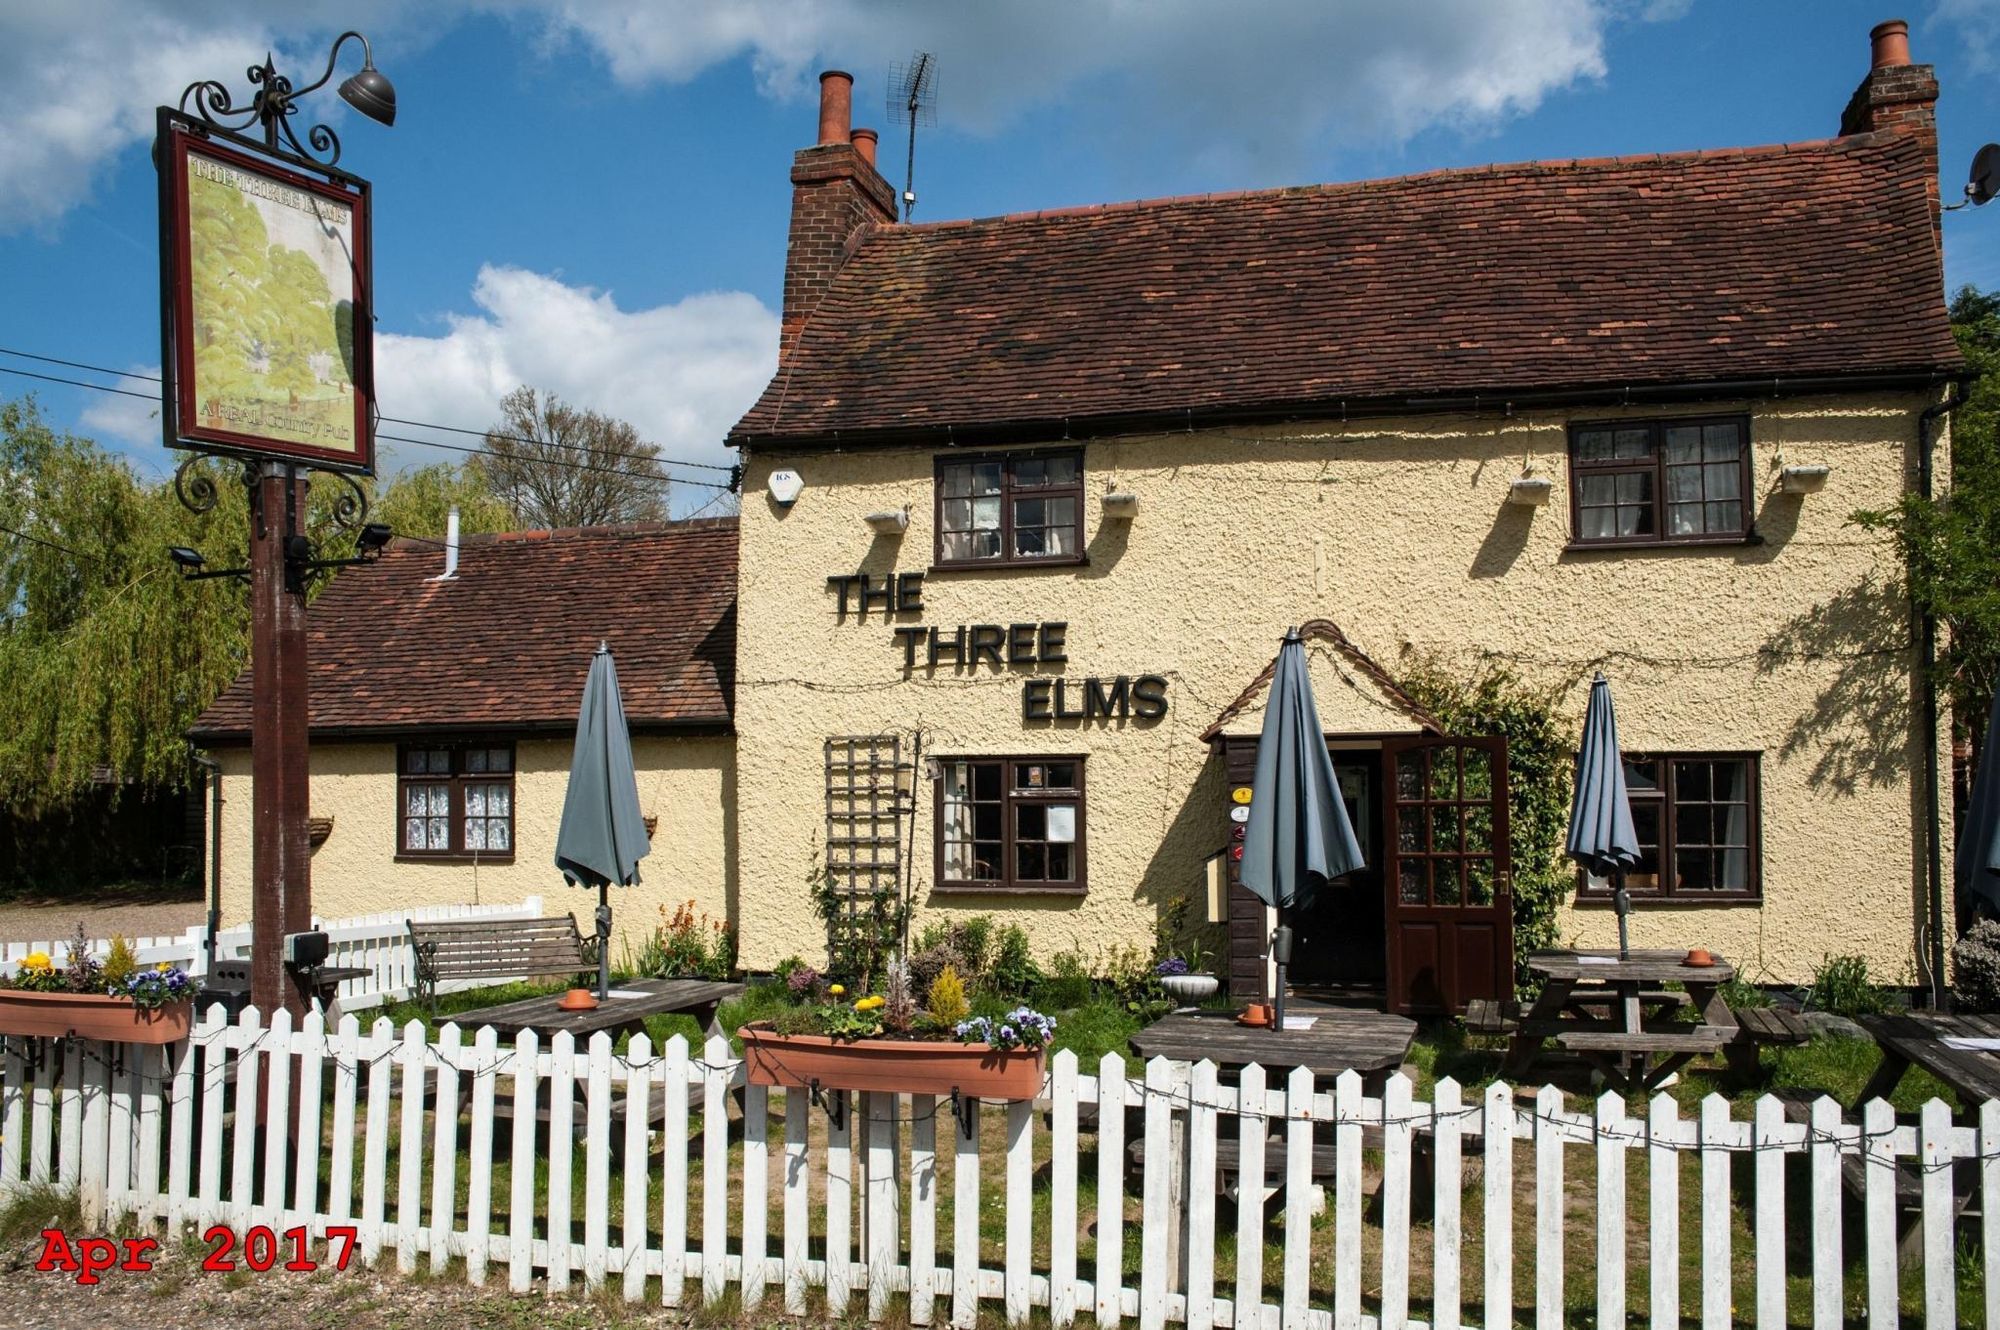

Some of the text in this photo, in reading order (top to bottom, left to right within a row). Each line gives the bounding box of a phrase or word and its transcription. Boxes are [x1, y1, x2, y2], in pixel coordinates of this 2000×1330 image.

[191, 157, 347, 225] THE THREE ELMS
[200, 399, 213, 417] A
[218, 404, 263, 426] REAL
[827, 572, 925, 614] THE
[894, 621, 1069, 667] THREE
[1025, 675, 1169, 720] ELMS
